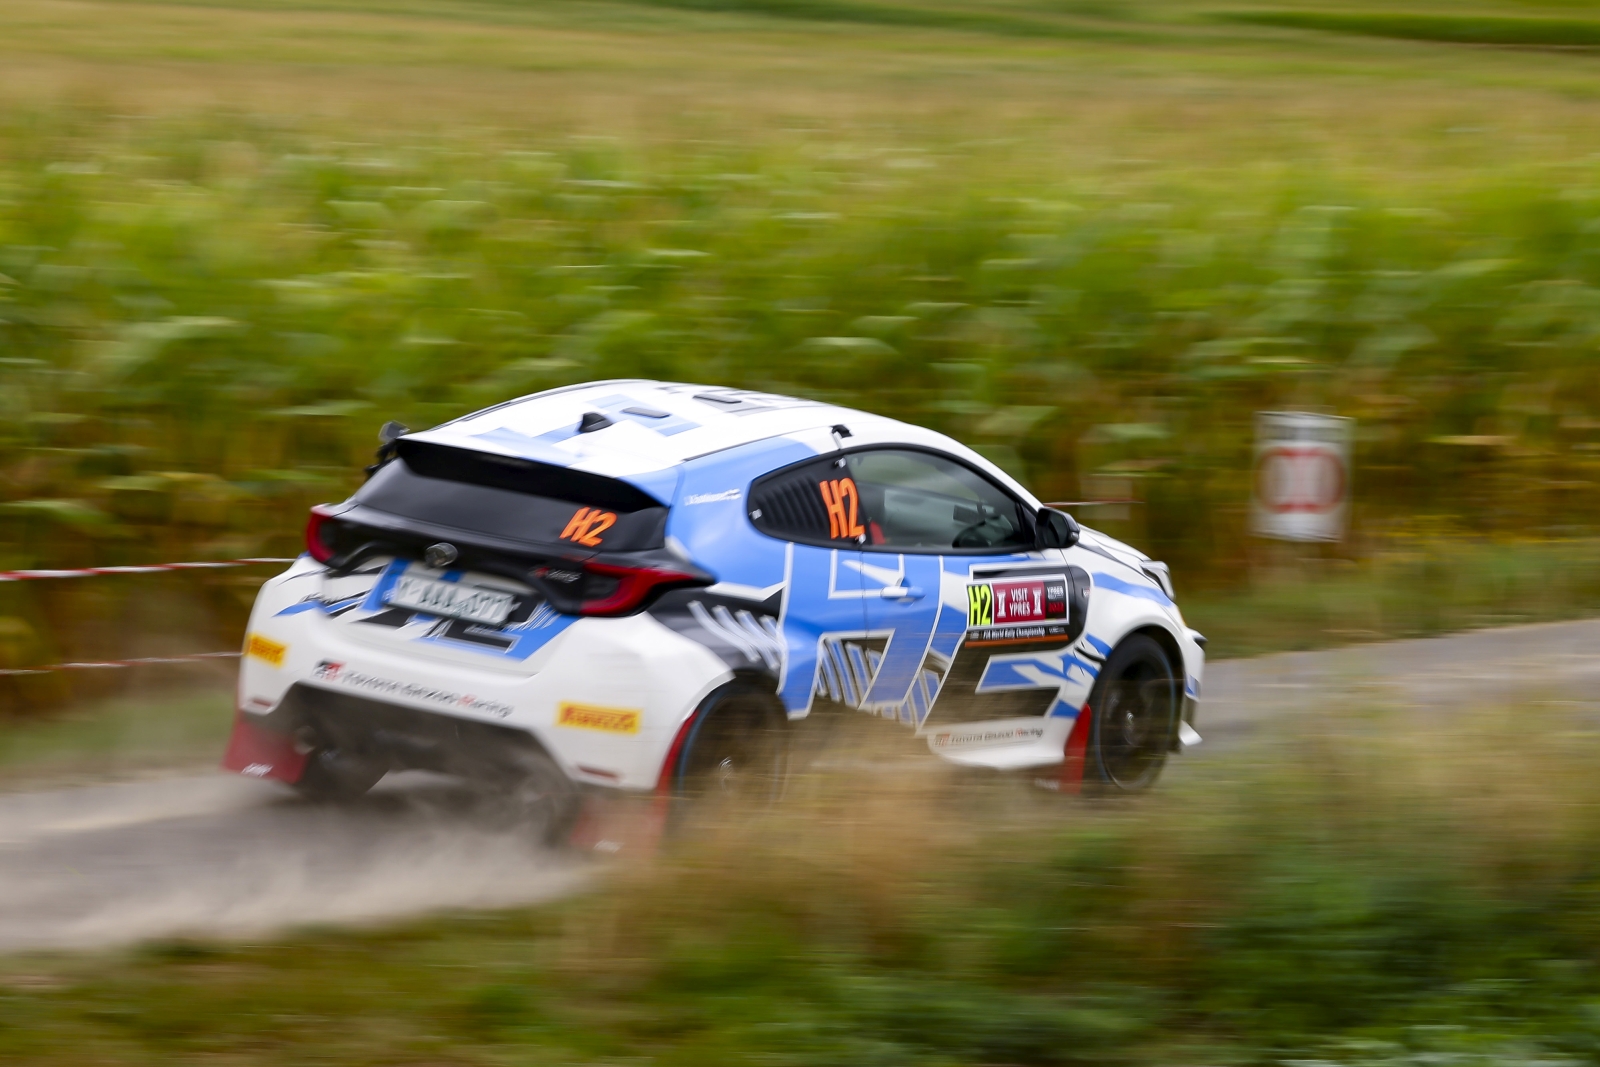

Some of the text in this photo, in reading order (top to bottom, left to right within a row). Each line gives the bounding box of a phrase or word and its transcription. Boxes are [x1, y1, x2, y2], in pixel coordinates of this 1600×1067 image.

[559, 506, 617, 547] H2
[819, 478, 866, 539] H2
[968, 584, 991, 626] H2
[1009, 602, 1031, 617] YPRES
[1010, 588, 1028, 602] VISIT
